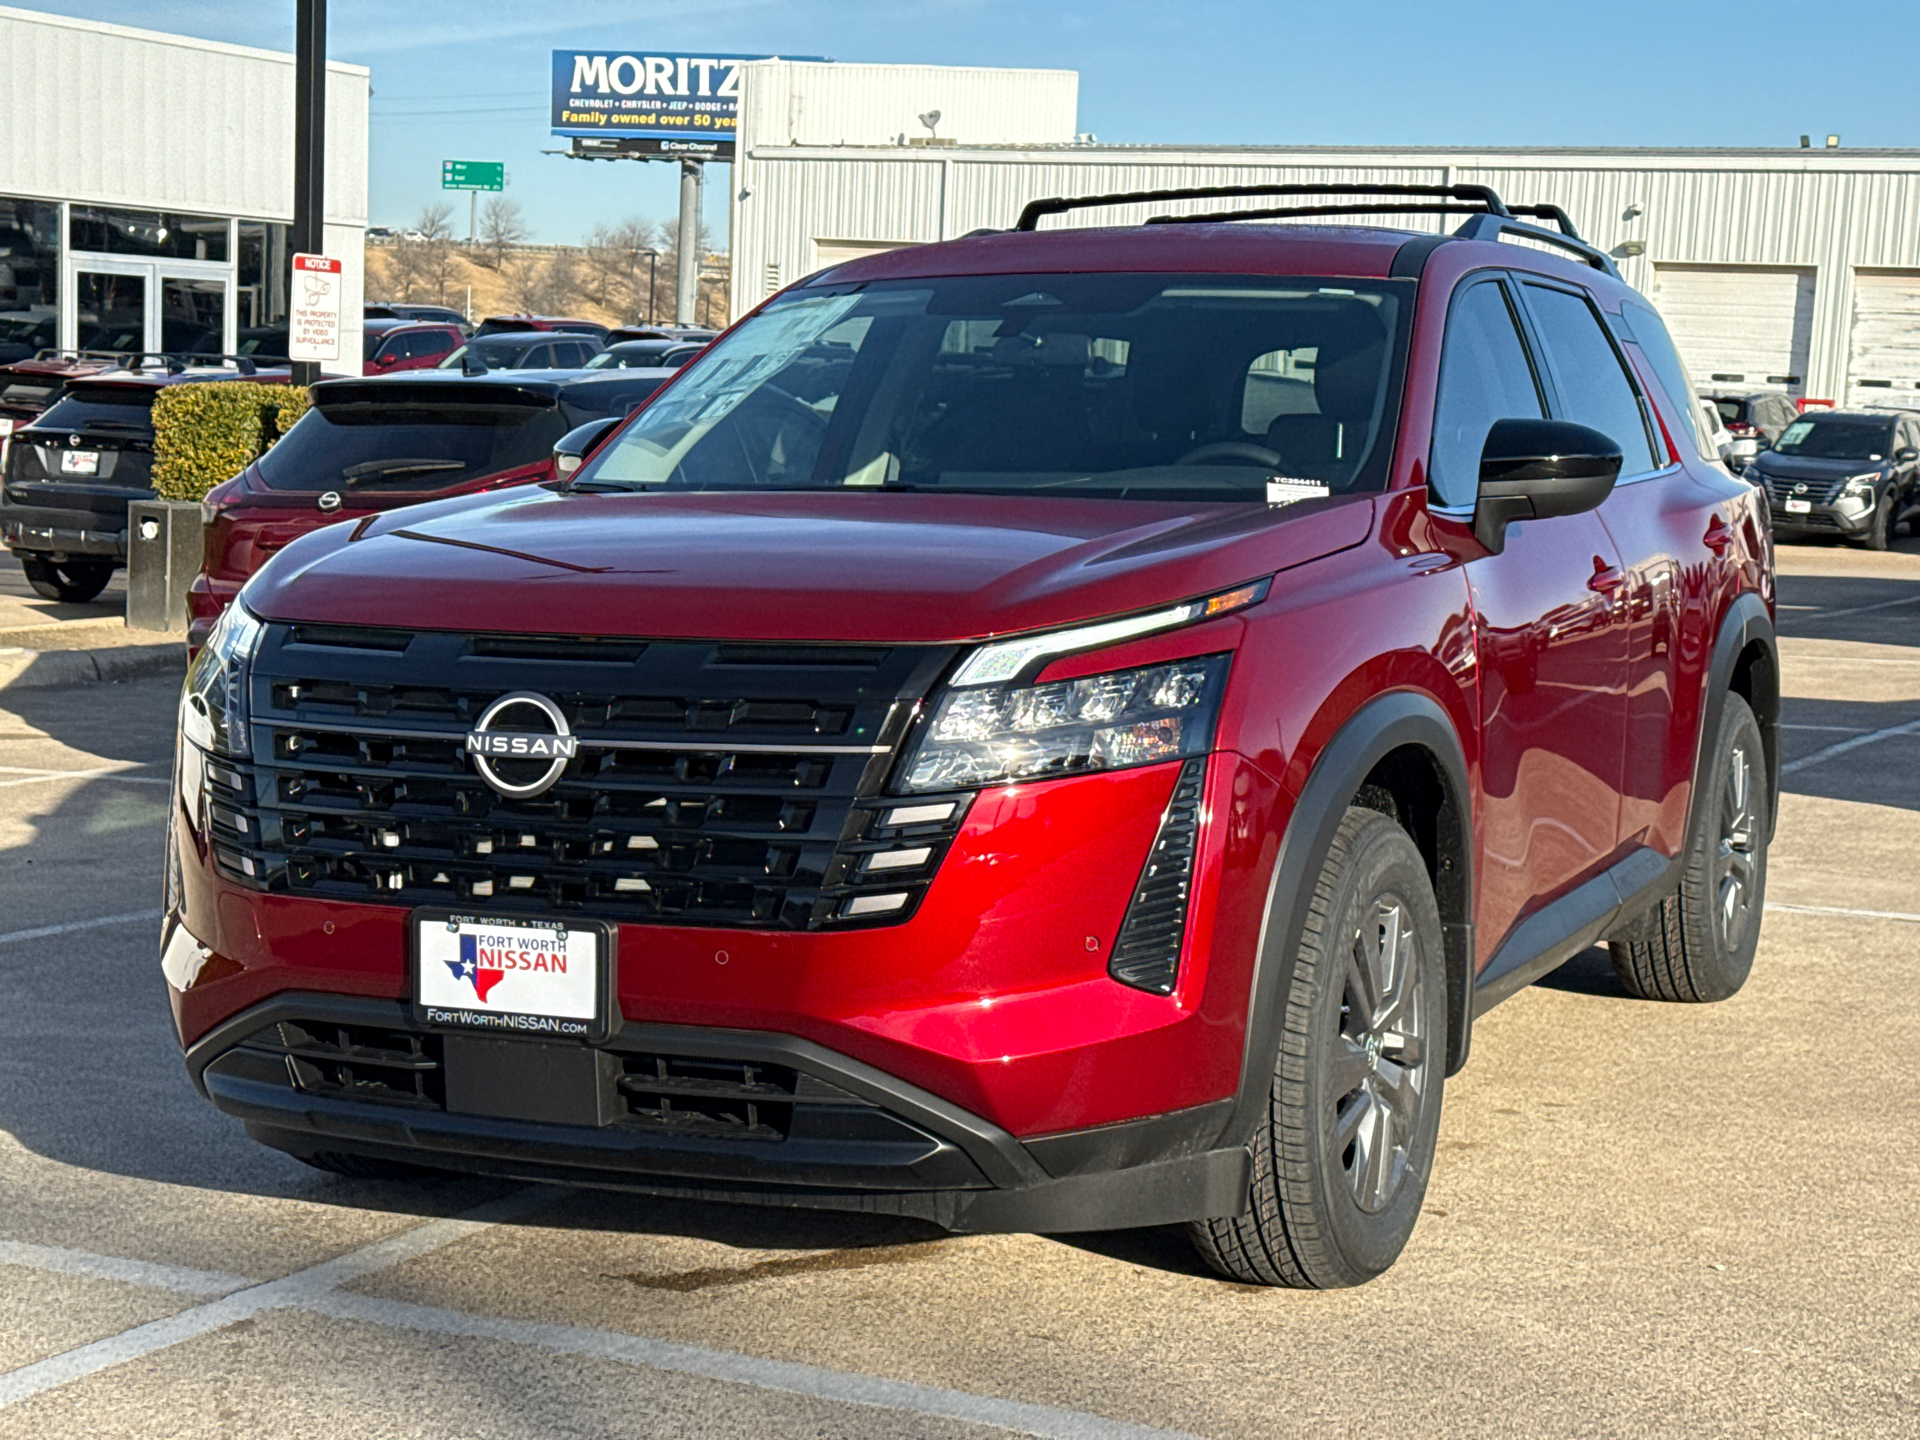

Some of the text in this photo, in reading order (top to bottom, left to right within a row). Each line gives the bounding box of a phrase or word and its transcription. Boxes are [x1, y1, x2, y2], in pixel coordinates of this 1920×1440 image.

[570, 55, 739, 97] MORITZ
[569, 98, 613, 108] CHEVROLET
[621, 99, 662, 109] CHRYSLER
[668, 101, 688, 111] JEEP
[694, 102, 721, 112] DODGE
[562, 111, 607, 125] Family
[611, 112, 656, 125] owned
[659, 115, 691, 126] over
[693, 114, 711, 126] 50
[669, 141, 688, 150] Clear
[304, 258, 331, 270] NOTICE
[296, 309, 337, 318] THIS PROPERTY
[304, 319, 336, 328] PROTECTED
[312, 328, 329, 336] VIDEO
[295, 336, 335, 346] SURVEILLANCE
[467, 734, 572, 755] NISSAN
[450, 914, 564, 930] FORT WORTH TEXAS
[478, 935, 567, 953] FORT WORTH
[479, 948, 567, 974] NISSAN
